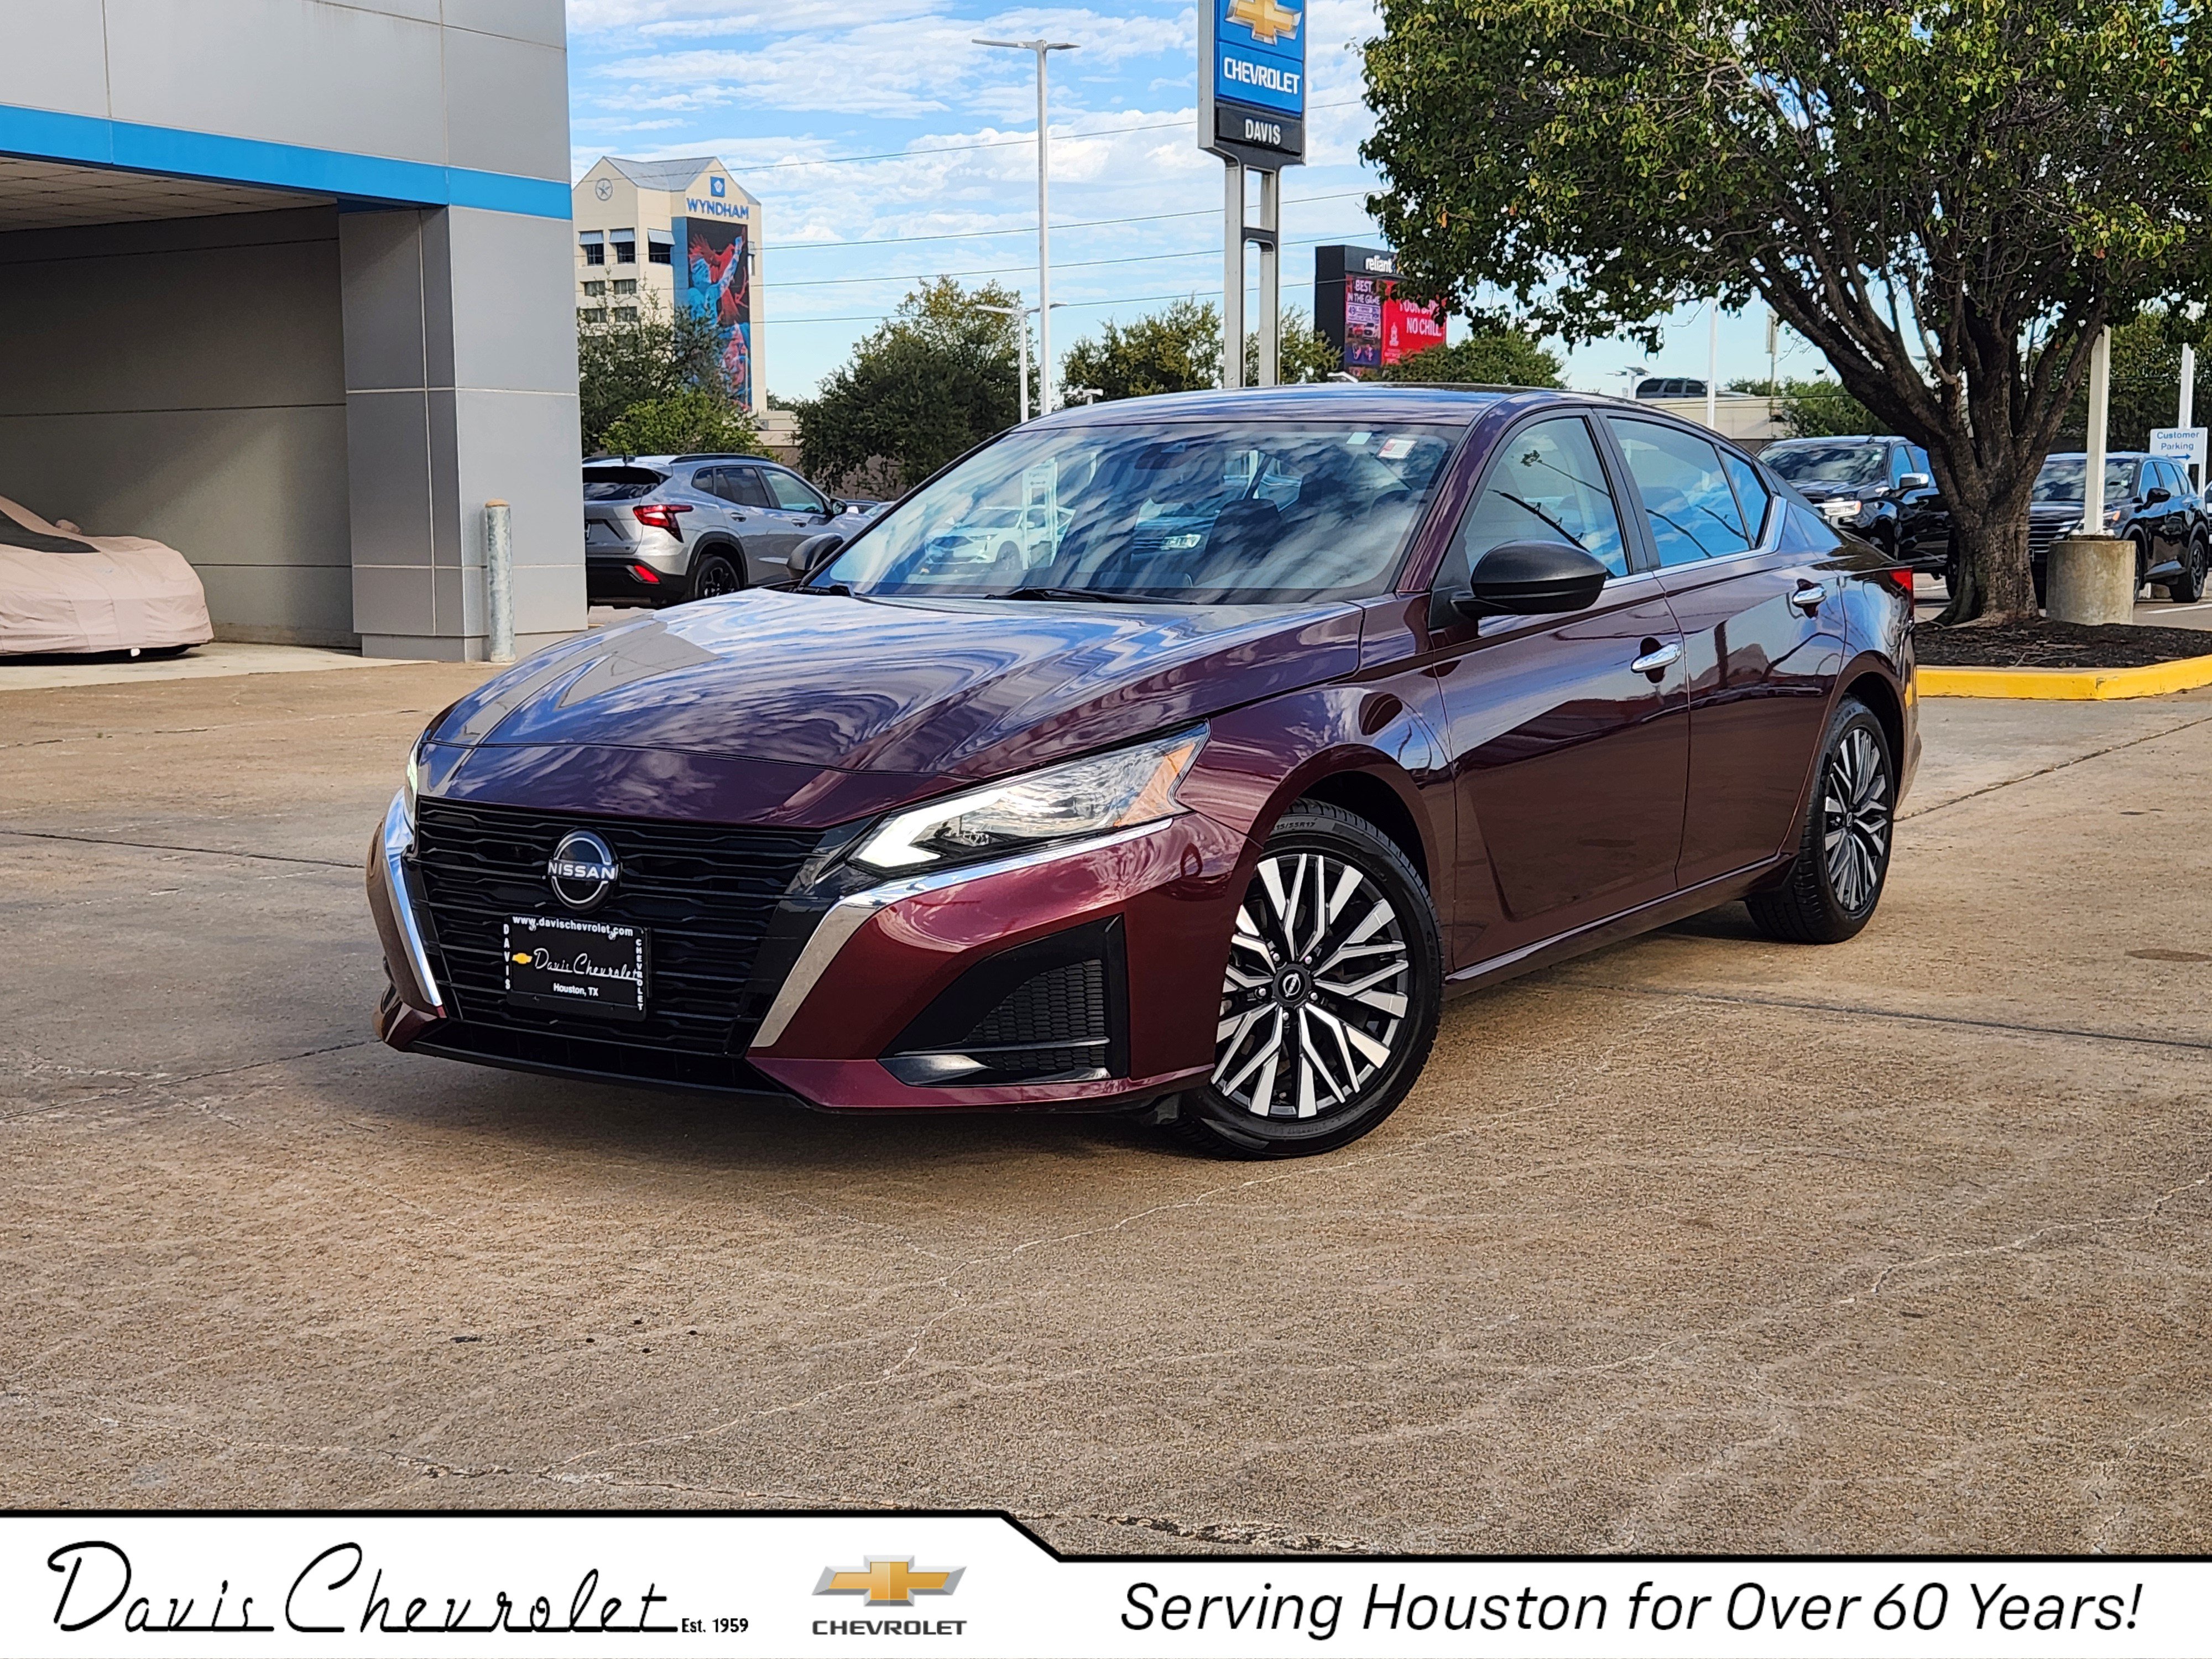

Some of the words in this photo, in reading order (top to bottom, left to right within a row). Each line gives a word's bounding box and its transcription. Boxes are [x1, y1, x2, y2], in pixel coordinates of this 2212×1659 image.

[1224, 57, 1301, 95] CHEVROLET
[1245, 118, 1281, 145] DAVIS
[686, 197, 749, 220] WYNDHAM
[1365, 255, 1392, 273] reliant
[1355, 279, 1373, 293] BEST
[1354, 293, 1365, 304] THE
[1406, 317, 1418, 335] NO
[2157, 431, 2199, 440] Customer
[2161, 442, 2194, 451] Parking
[547, 860, 616, 880] NISSAN
[512, 916, 634, 938] www.davischevrolet.com
[533, 947, 572, 973] Davis
[572, 953, 640, 982] Chevrolet
[635, 938, 644, 1011] CHEVROLET
[553, 983, 587, 997] Houston,
[588, 987, 599, 997] TX
